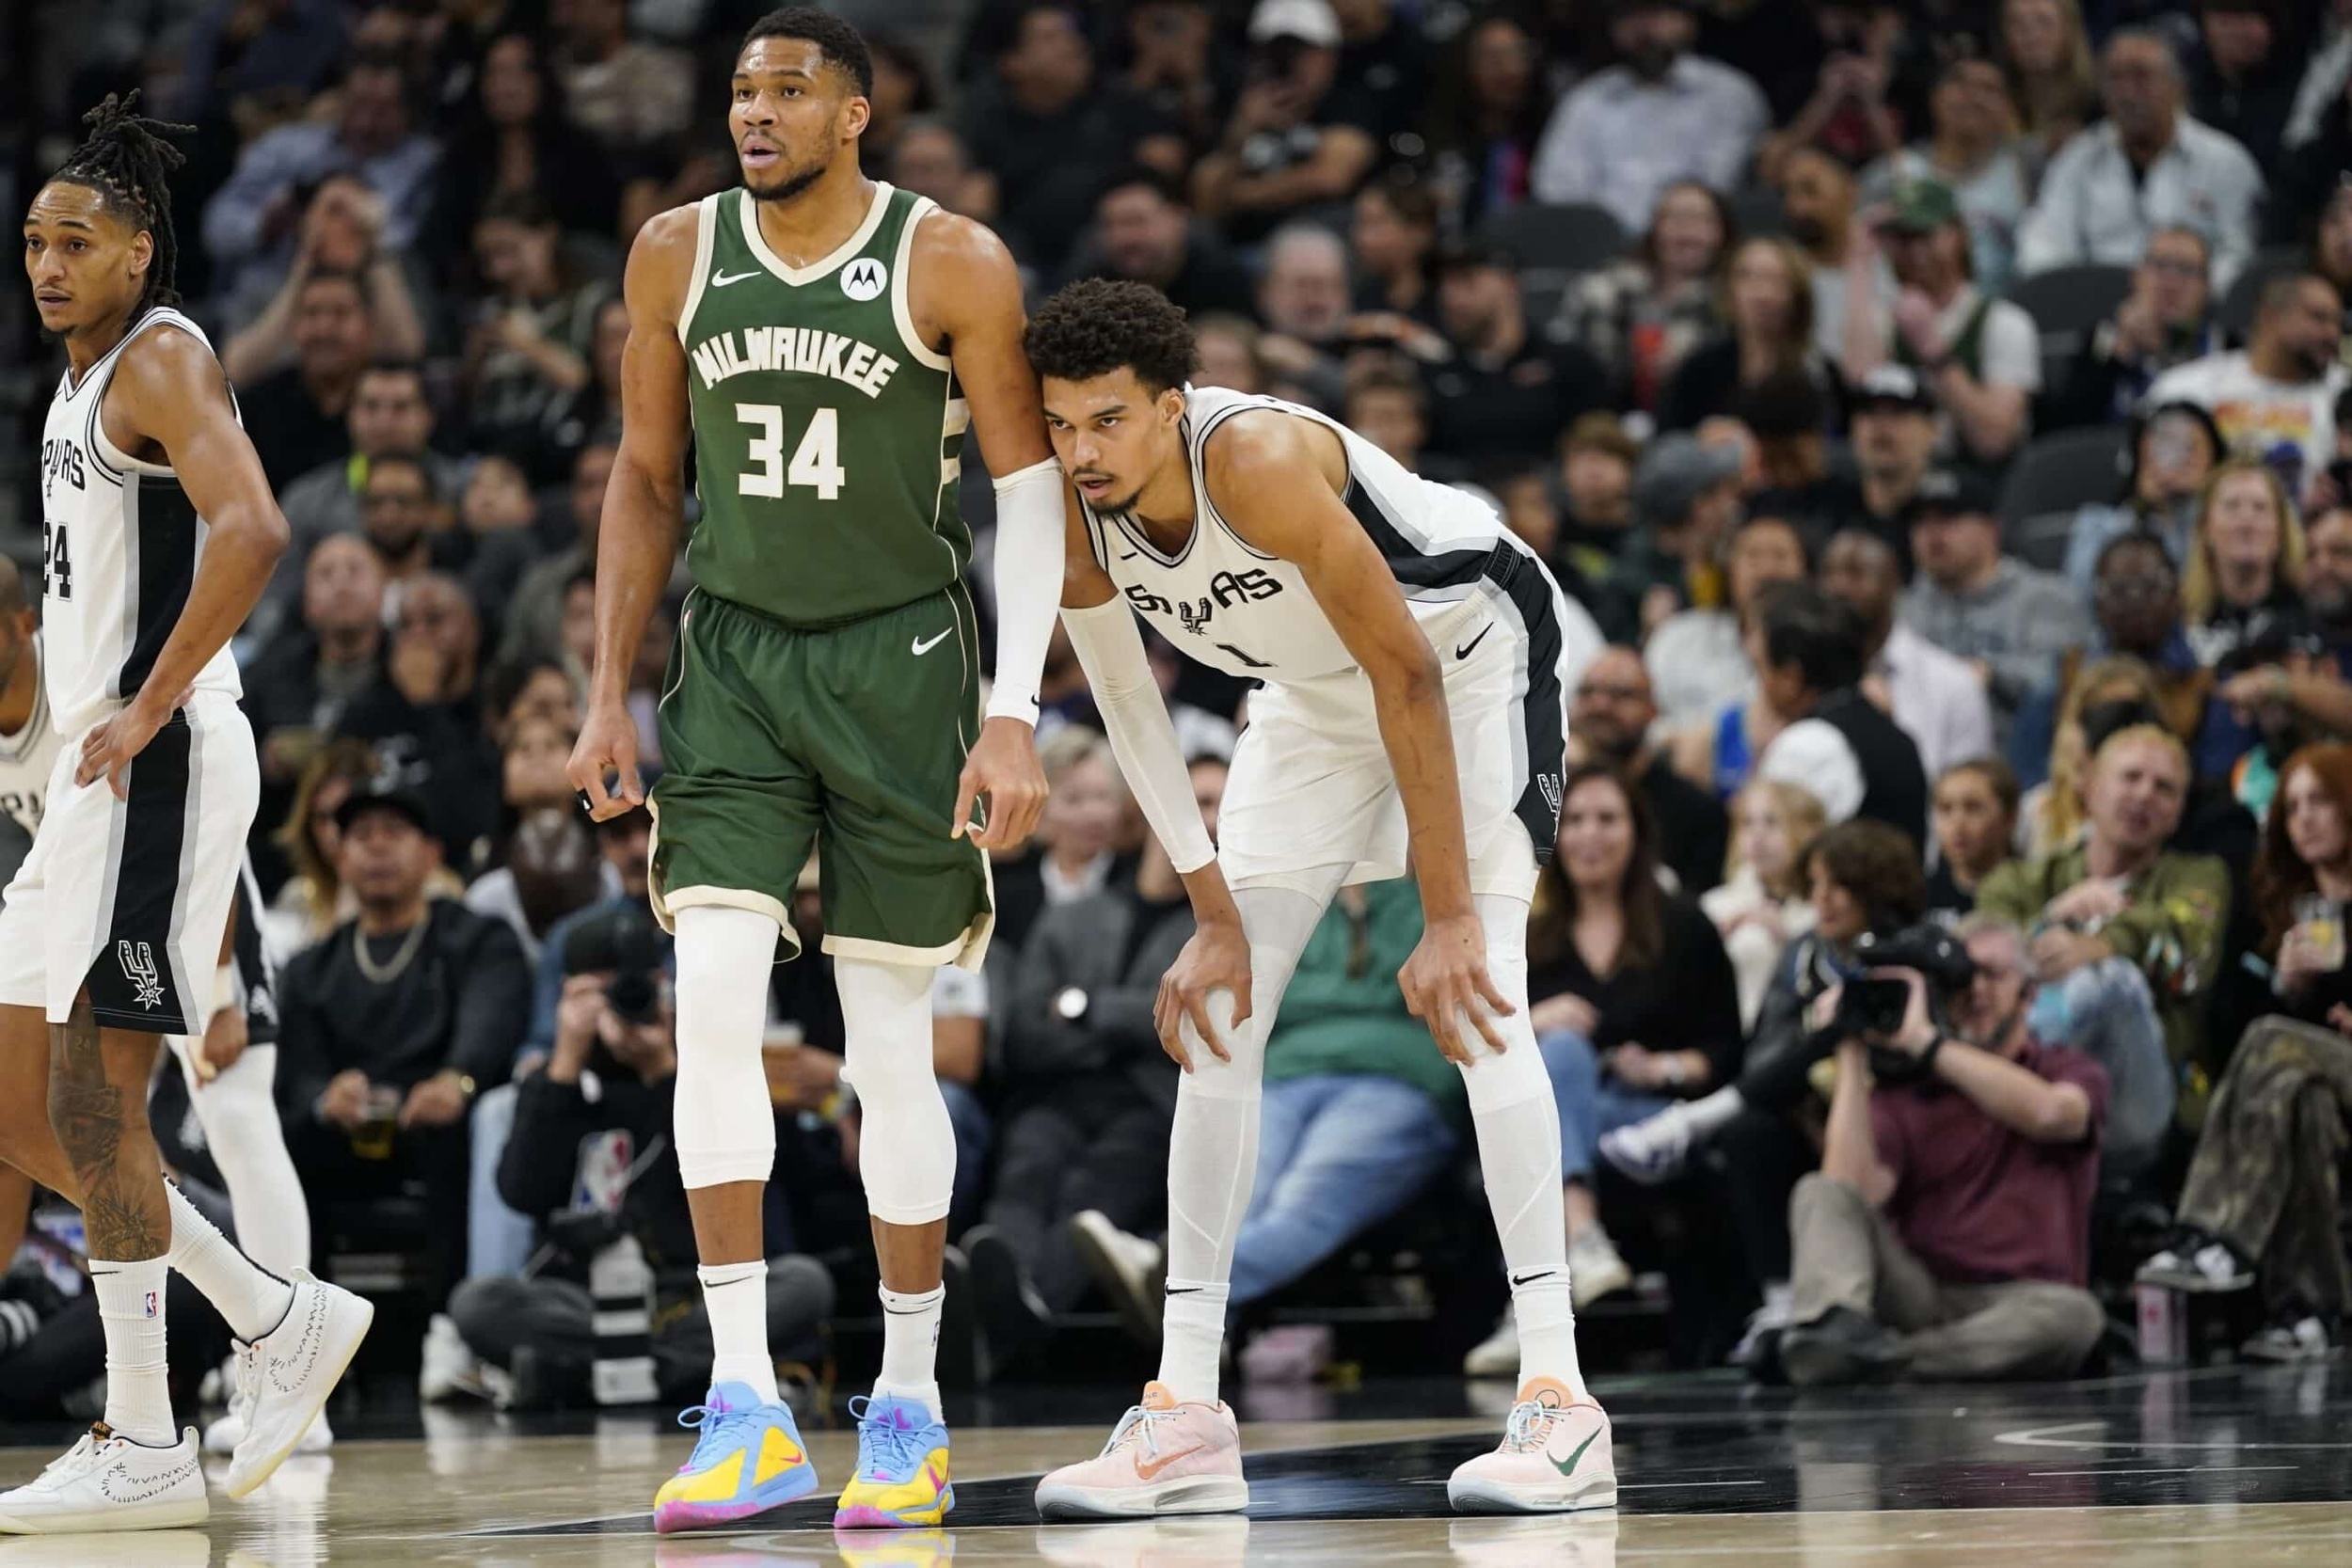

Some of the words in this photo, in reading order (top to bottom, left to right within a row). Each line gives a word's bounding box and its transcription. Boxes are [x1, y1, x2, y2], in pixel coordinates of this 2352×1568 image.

[691, 326, 899, 399] MILWAUKEE
[42, 438, 87, 495] PURS
[735, 403, 846, 500] 34
[1213, 641, 1279, 668] 1
